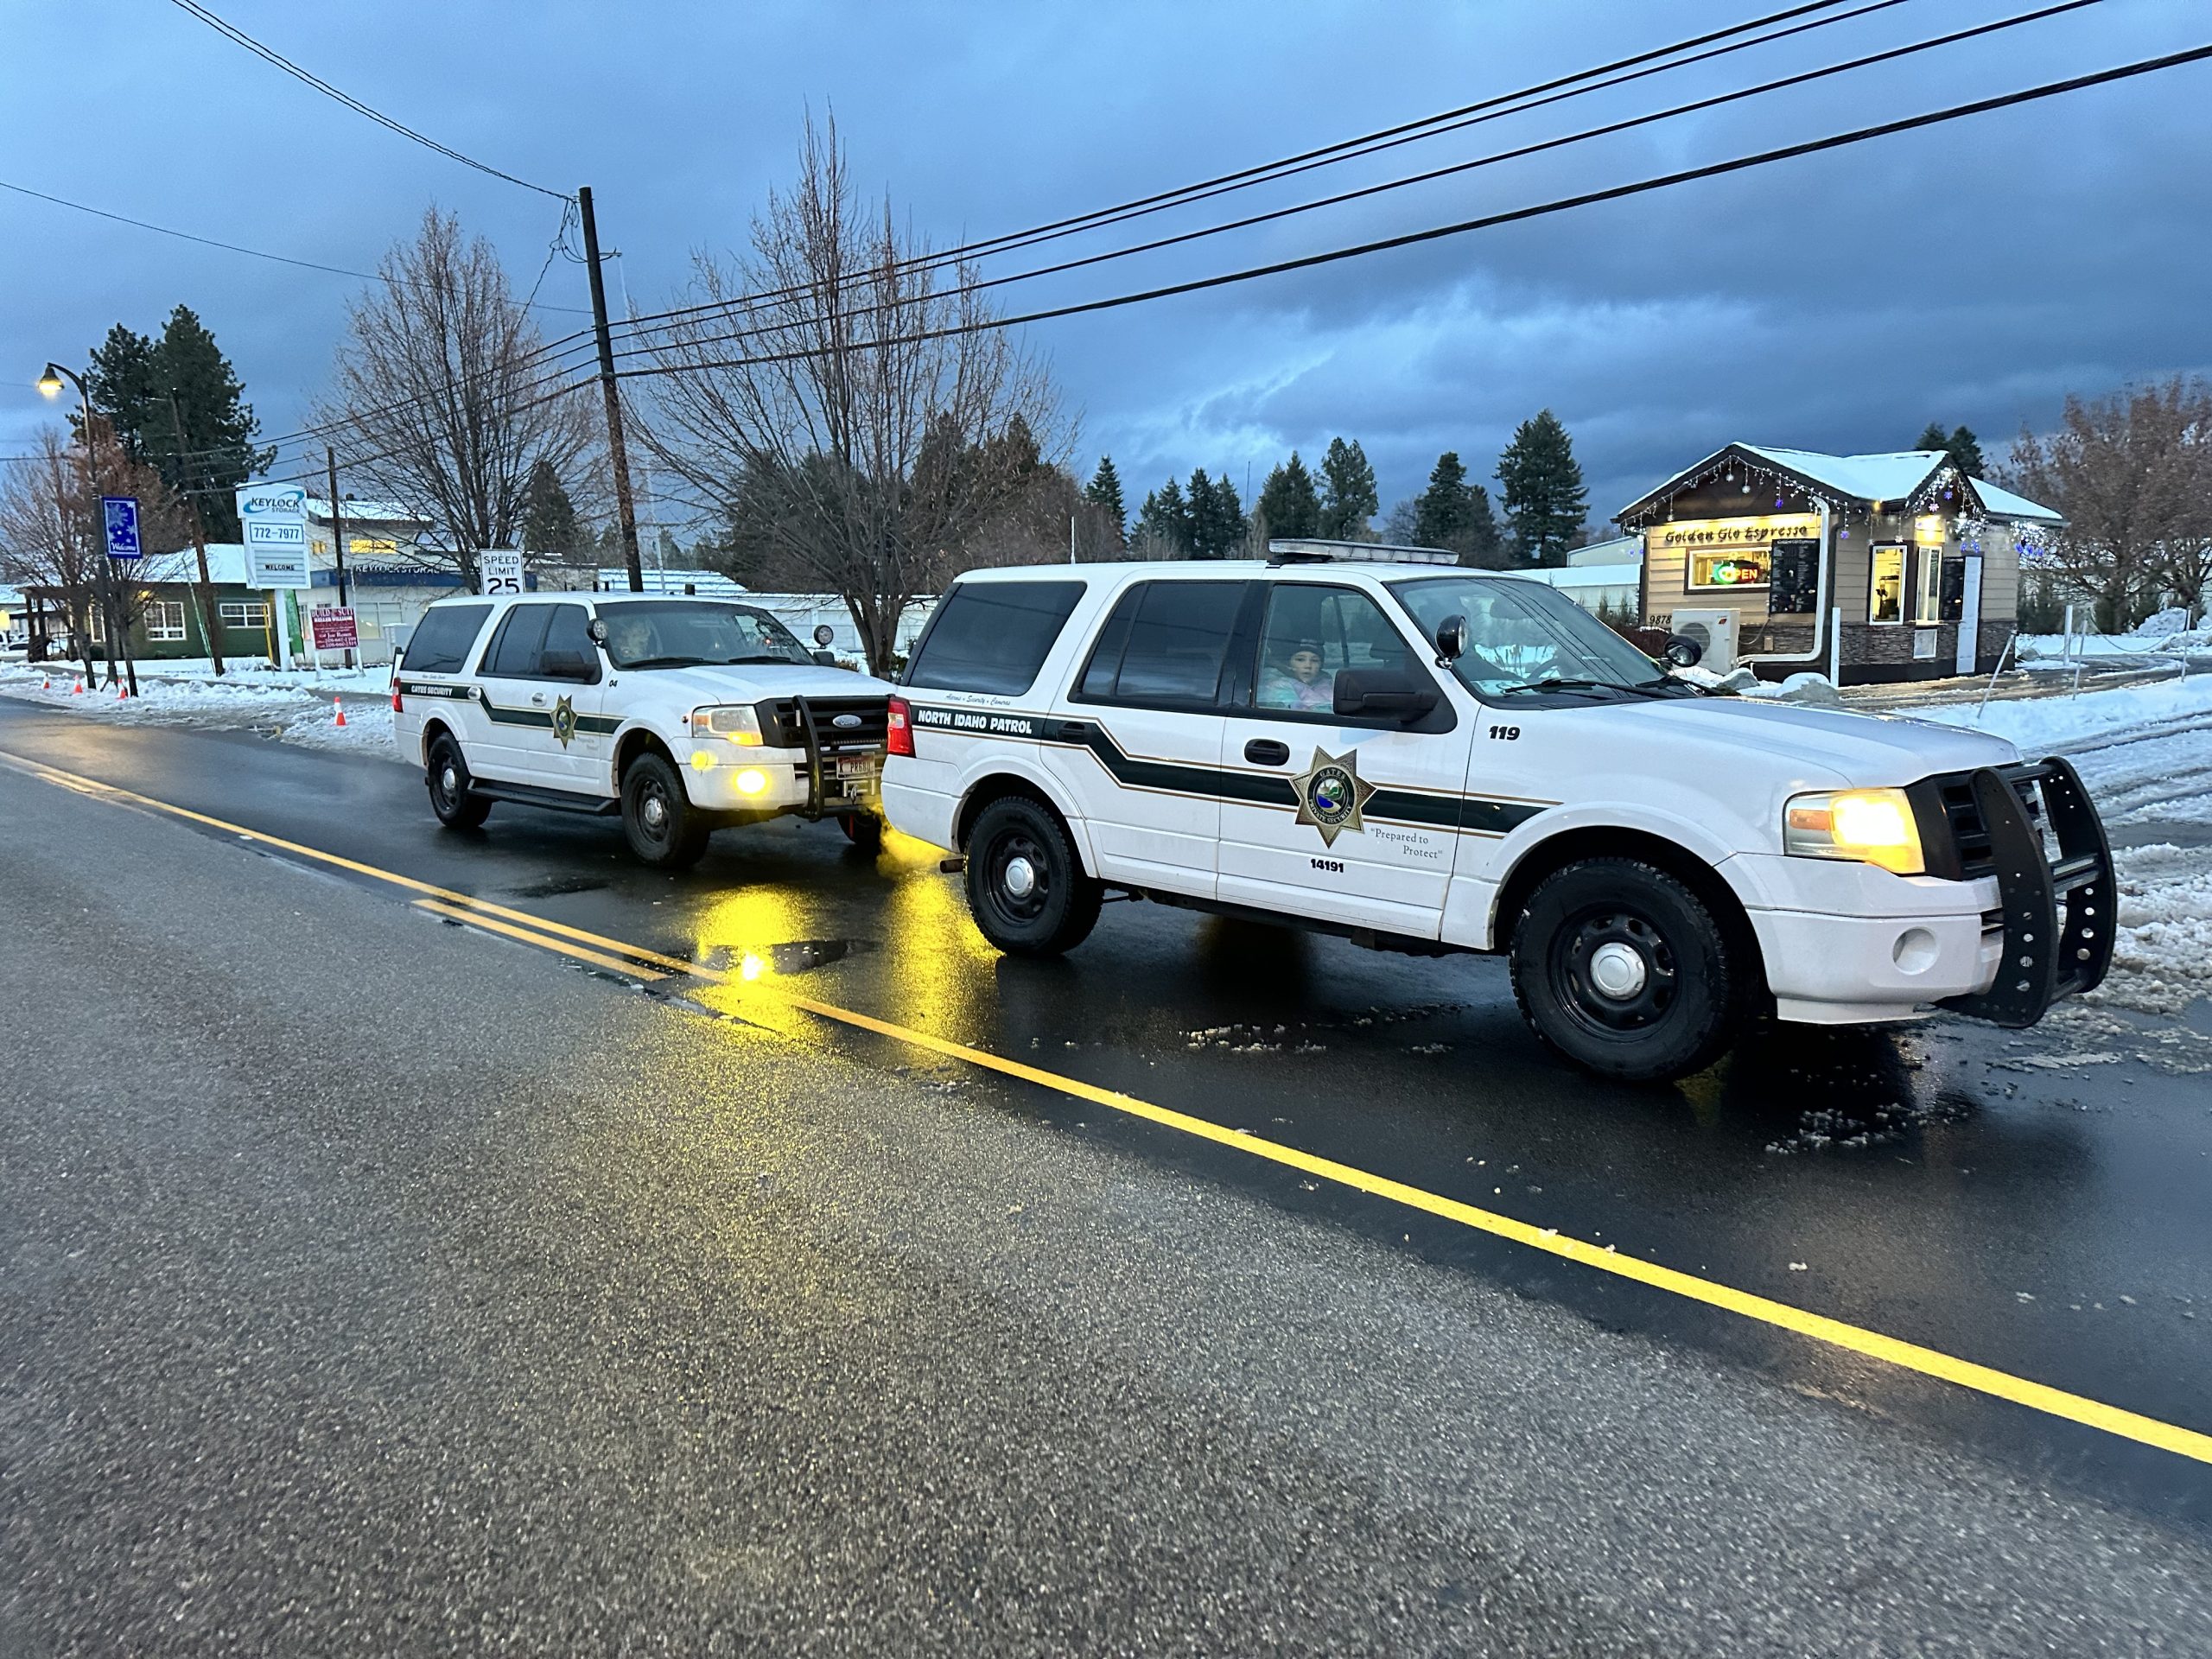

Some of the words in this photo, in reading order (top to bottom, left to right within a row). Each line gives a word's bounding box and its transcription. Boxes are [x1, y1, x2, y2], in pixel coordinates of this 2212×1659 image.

[251, 498, 300, 508] KEYLOCK
[254, 527, 300, 539] 772-7977
[1665, 530, 1714, 543] Golden
[1718, 528, 1740, 542] Glo
[1745, 526, 1808, 541] Espresso
[483, 556, 518, 564] SPEED
[488, 567, 517, 575] LIMIT
[486, 577, 520, 594] 25
[1649, 614, 1673, 625] 9878
[608, 679, 618, 688] 04
[427, 686, 453, 696] SECURITY
[918, 710, 951, 726] NORTH
[954, 714, 988, 728] IDAHO
[990, 718, 1033, 734] PATROL
[1489, 725, 1521, 741] 119
[1319, 768, 1346, 779] GATES
[1308, 798, 1327, 823] PRIVATE
[1326, 805, 1353, 823] SECURITY
[1418, 835, 1429, 844] to
[1310, 858, 1344, 874] 14191
